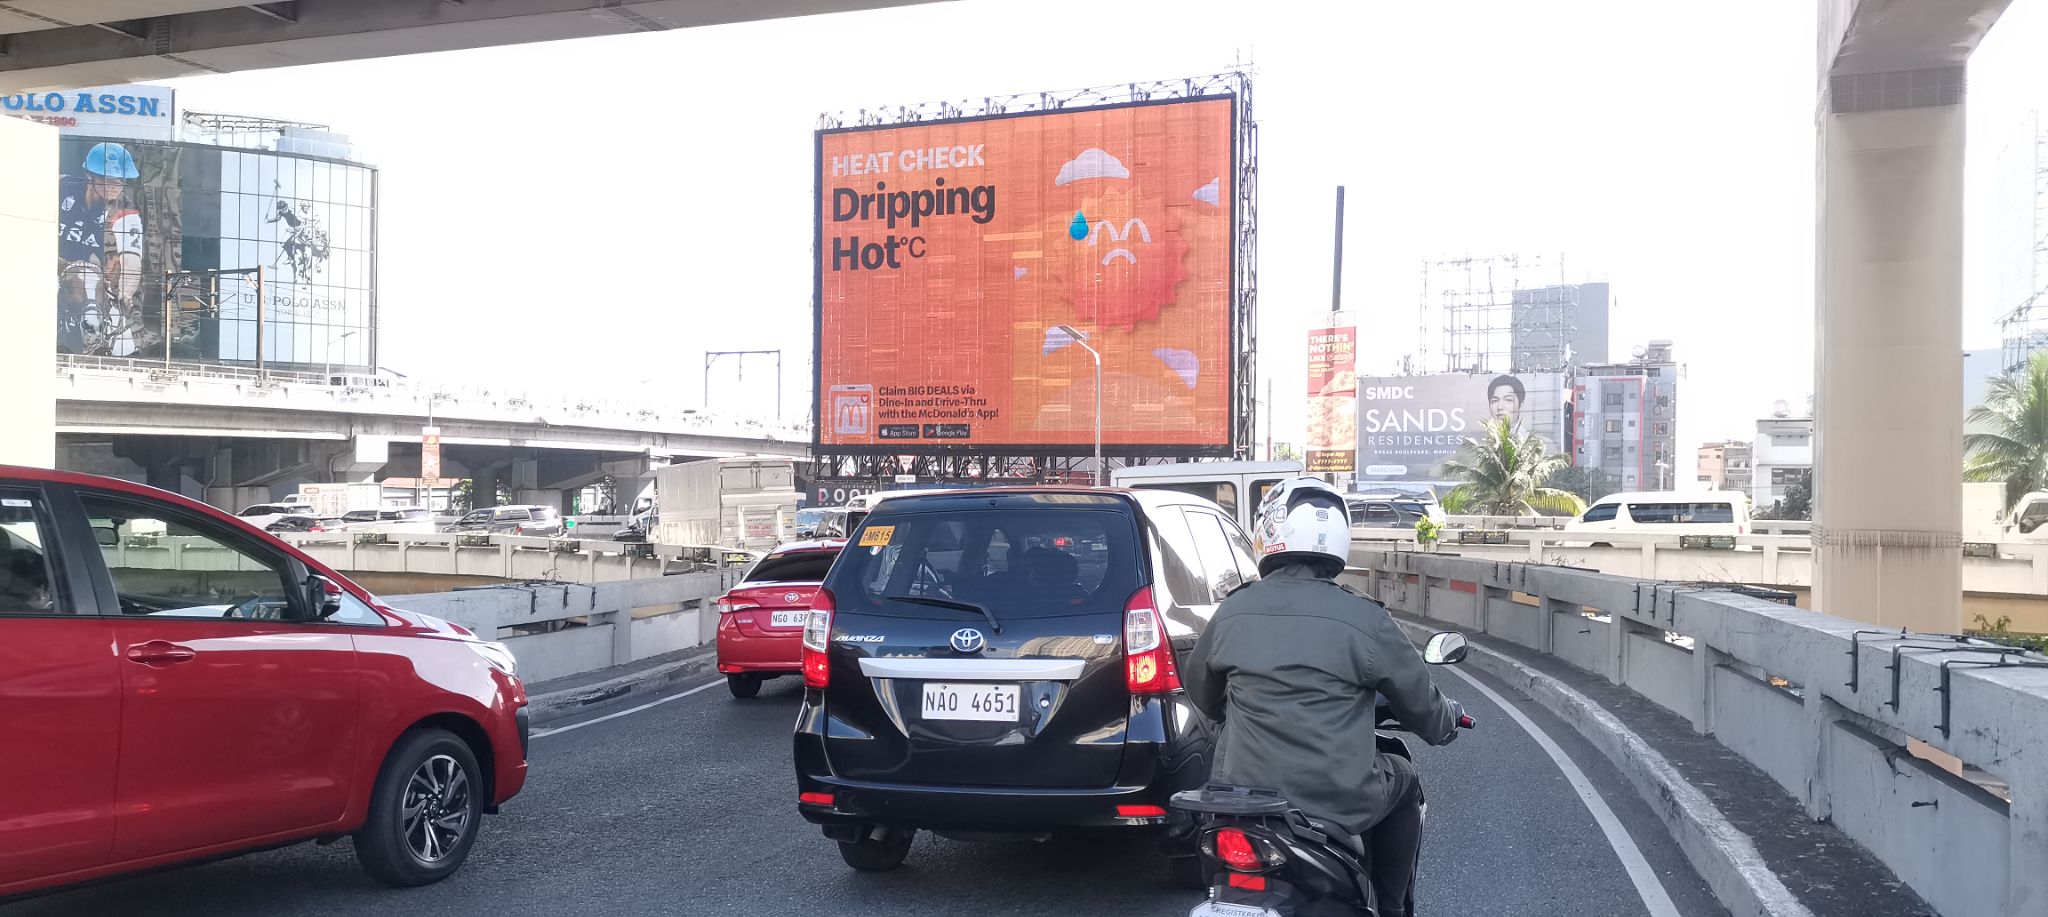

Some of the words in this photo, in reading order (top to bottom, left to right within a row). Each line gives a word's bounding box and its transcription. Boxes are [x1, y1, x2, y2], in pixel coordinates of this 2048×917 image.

[0, 92, 65, 112] OLO
[74, 92, 166, 117] ASSN.
[832, 152, 894, 177] HEAT
[899, 143, 985, 173] CHECK
[833, 177, 996, 229] Dripping
[272, 296, 309, 308] POLO
[1310, 334, 1348, 344] THERE'S
[1310, 342, 1353, 353] NOTHIN'
[879, 387, 906, 396] Claim
[908, 386, 925, 395] BIG
[927, 386, 959, 395] DEALS
[960, 385, 975, 394] via
[1366, 386, 1414, 400] SMDC
[879, 398, 914, 407] Dine-In
[916, 398, 934, 407] and
[935, 397, 986, 406] Drive-Thru
[879, 409, 899, 418] with
[901, 409, 917, 418] the
[918, 408, 974, 418] McDonald's
[977, 408, 999, 420] App!
[1366, 408, 1466, 433] SANDS
[1368, 435, 1464, 446] RESIDENCES
[773, 614, 788, 623] NGO
[835, 635, 885, 643] AVANZA
[925, 692, 958, 712] NAO
[971, 693, 1015, 713] 4651
